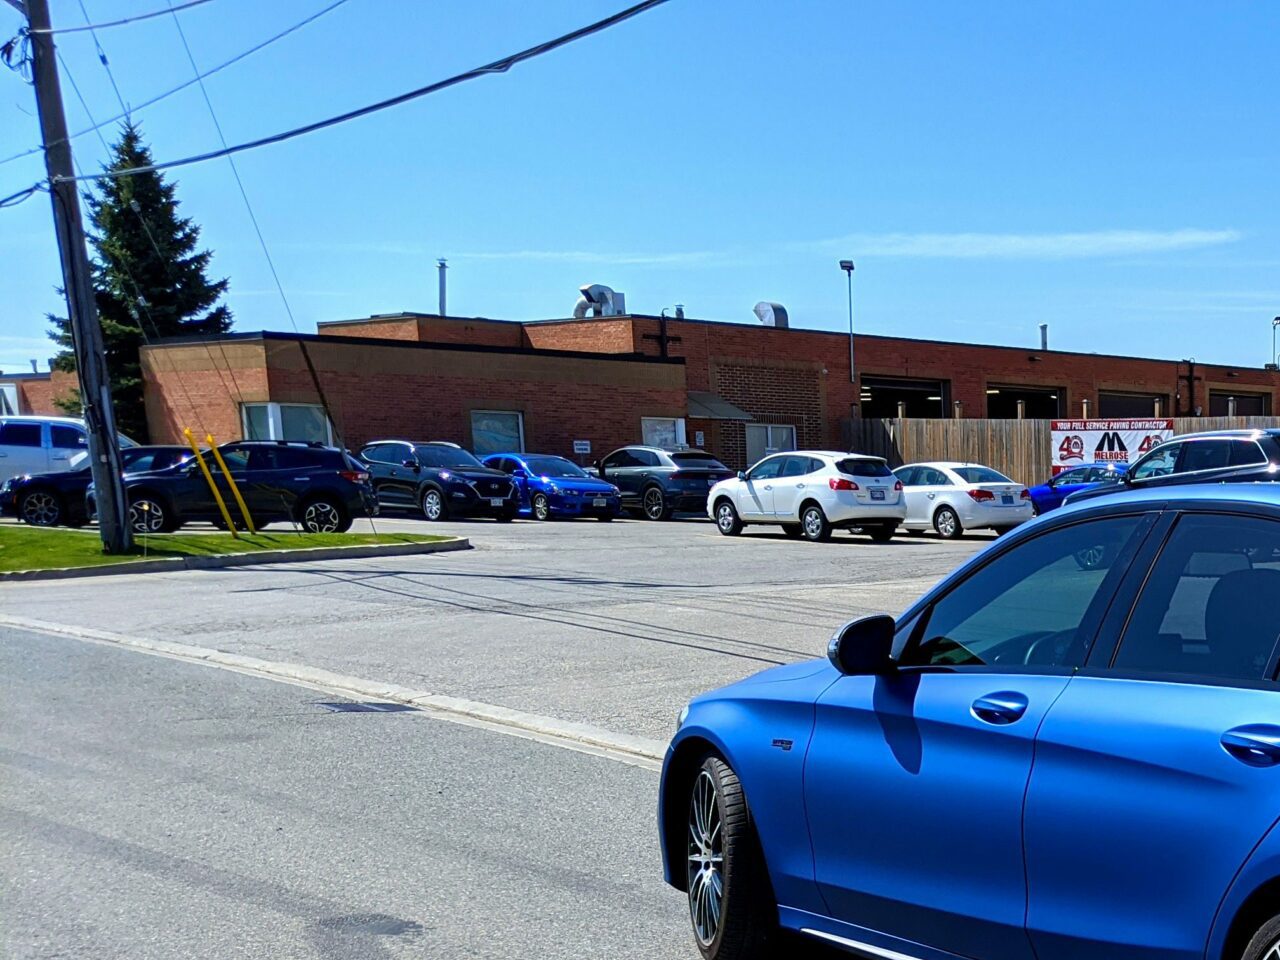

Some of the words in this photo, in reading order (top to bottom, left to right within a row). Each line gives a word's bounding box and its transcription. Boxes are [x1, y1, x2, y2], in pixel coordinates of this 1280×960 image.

[1056, 422, 1071, 430] YOUR
[1071, 422, 1085, 430] FULL
[1086, 422, 1108, 430] SERVICE
[1109, 421, 1130, 429] PAVING
[1130, 421, 1168, 429] CONTRACTOR
[1094, 451, 1129, 460] MELROSE
